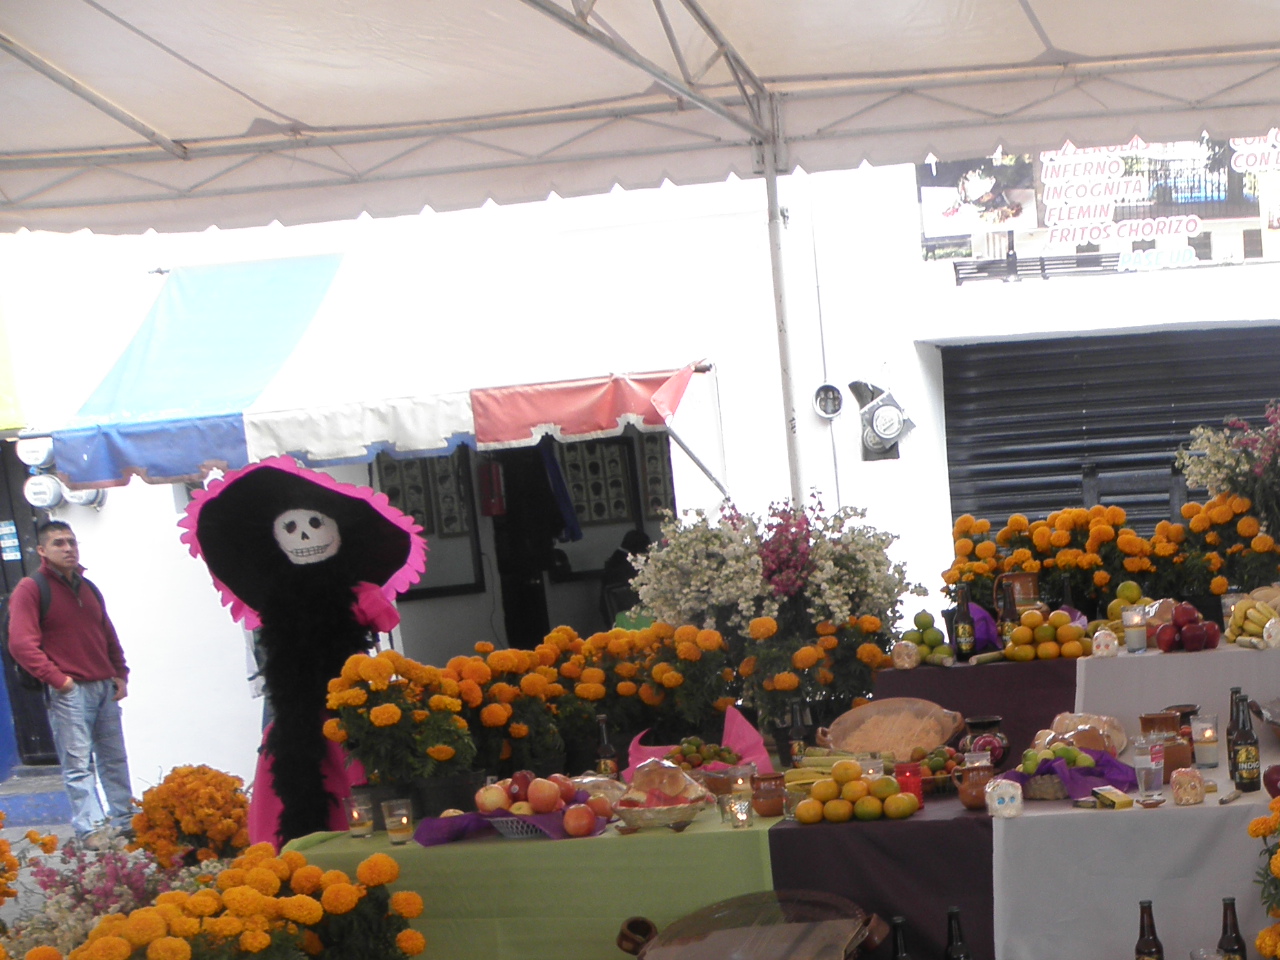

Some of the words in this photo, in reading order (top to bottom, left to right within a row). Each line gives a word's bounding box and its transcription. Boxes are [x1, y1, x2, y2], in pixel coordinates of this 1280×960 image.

[1043, 159, 1121, 179] INFERNO
[1232, 151, 1271, 168] CON
[1045, 179, 1143, 201] INCOGNITA
[1047, 203, 1111, 222] FLEMIN
[1049, 224, 1112, 244] FRITOS
[1116, 218, 1198, 239] CHORIZO
[1238, 761, 1260, 770] INDIO
